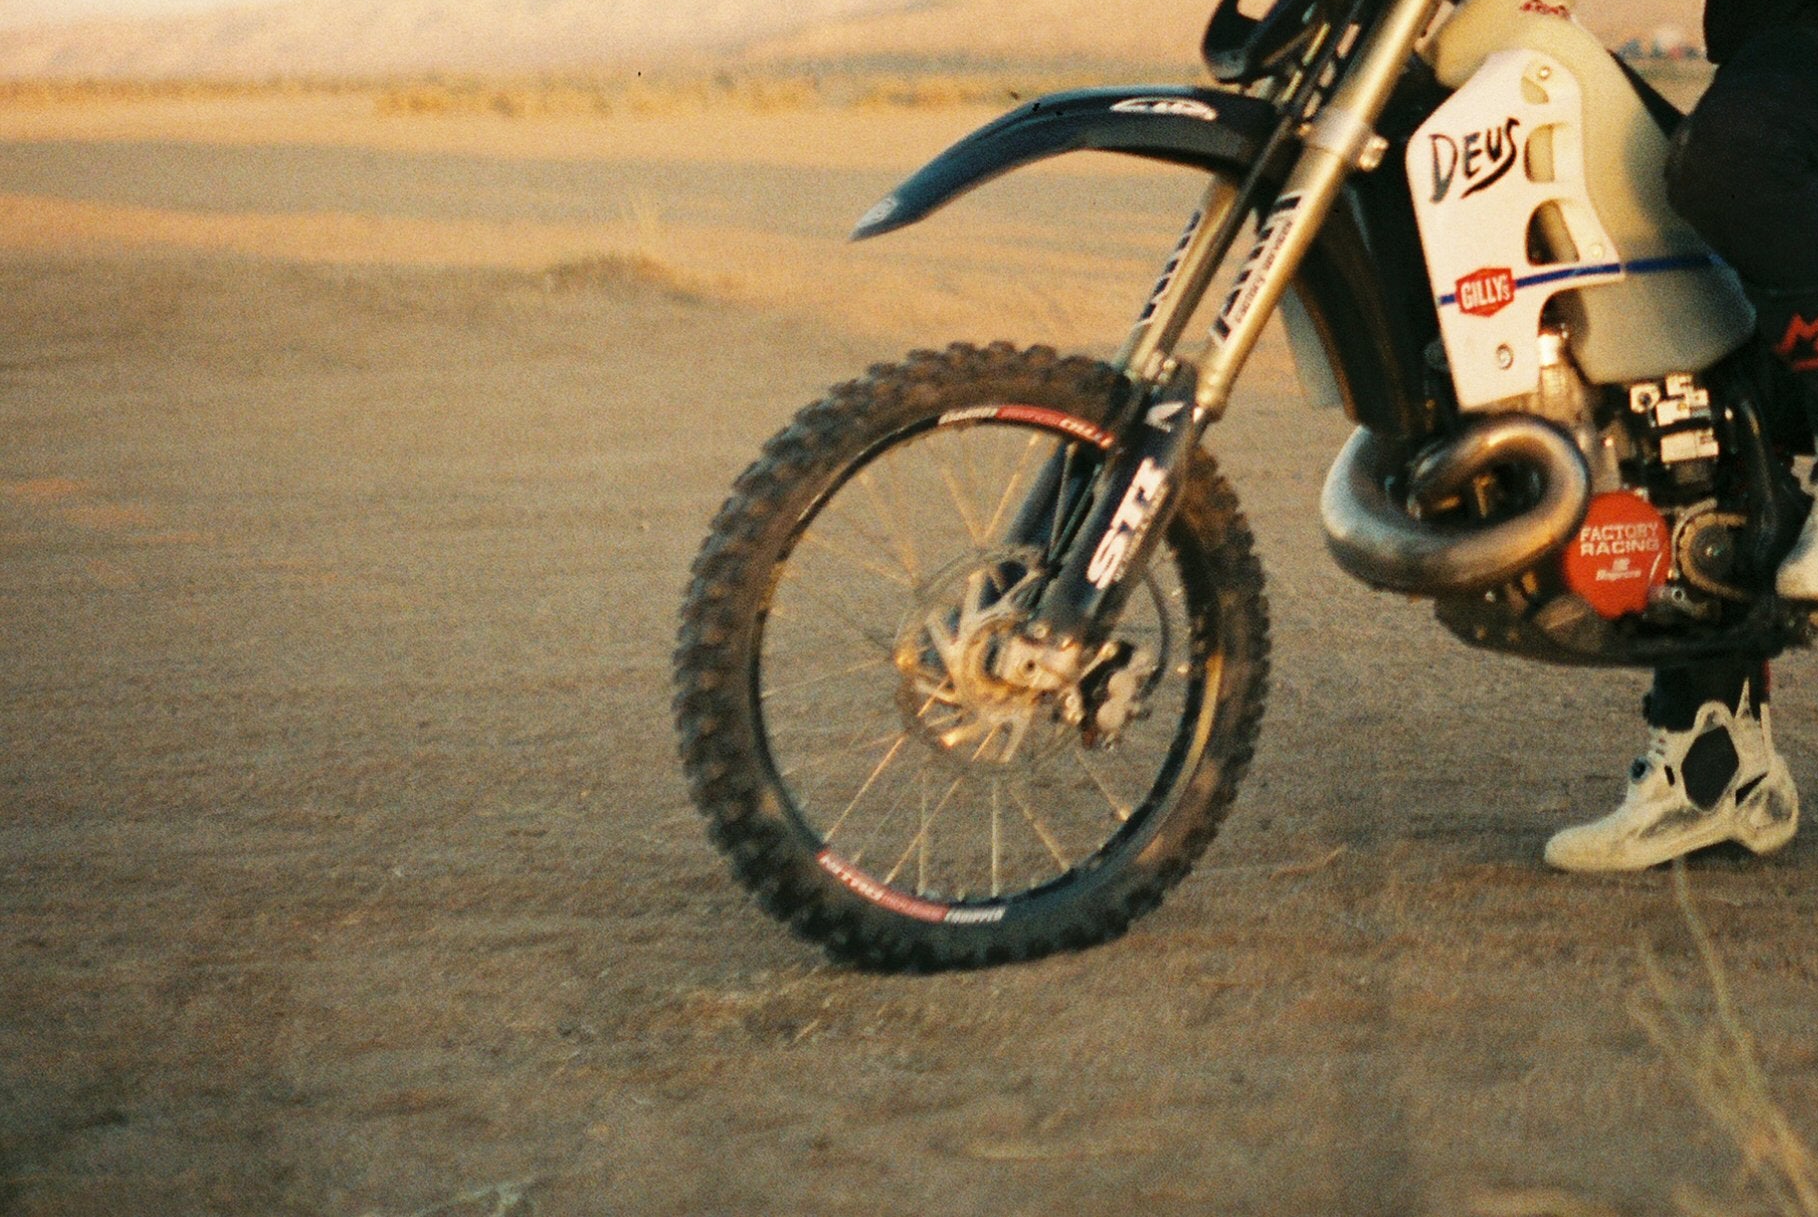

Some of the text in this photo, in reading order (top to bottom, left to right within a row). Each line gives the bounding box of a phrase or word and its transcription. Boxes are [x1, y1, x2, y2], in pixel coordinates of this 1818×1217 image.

[1429, 116, 1520, 205] DEUS
[1087, 457, 1169, 590] STI
[1580, 522, 1659, 542] FACTORY
[1580, 538, 1660, 557] RACING
